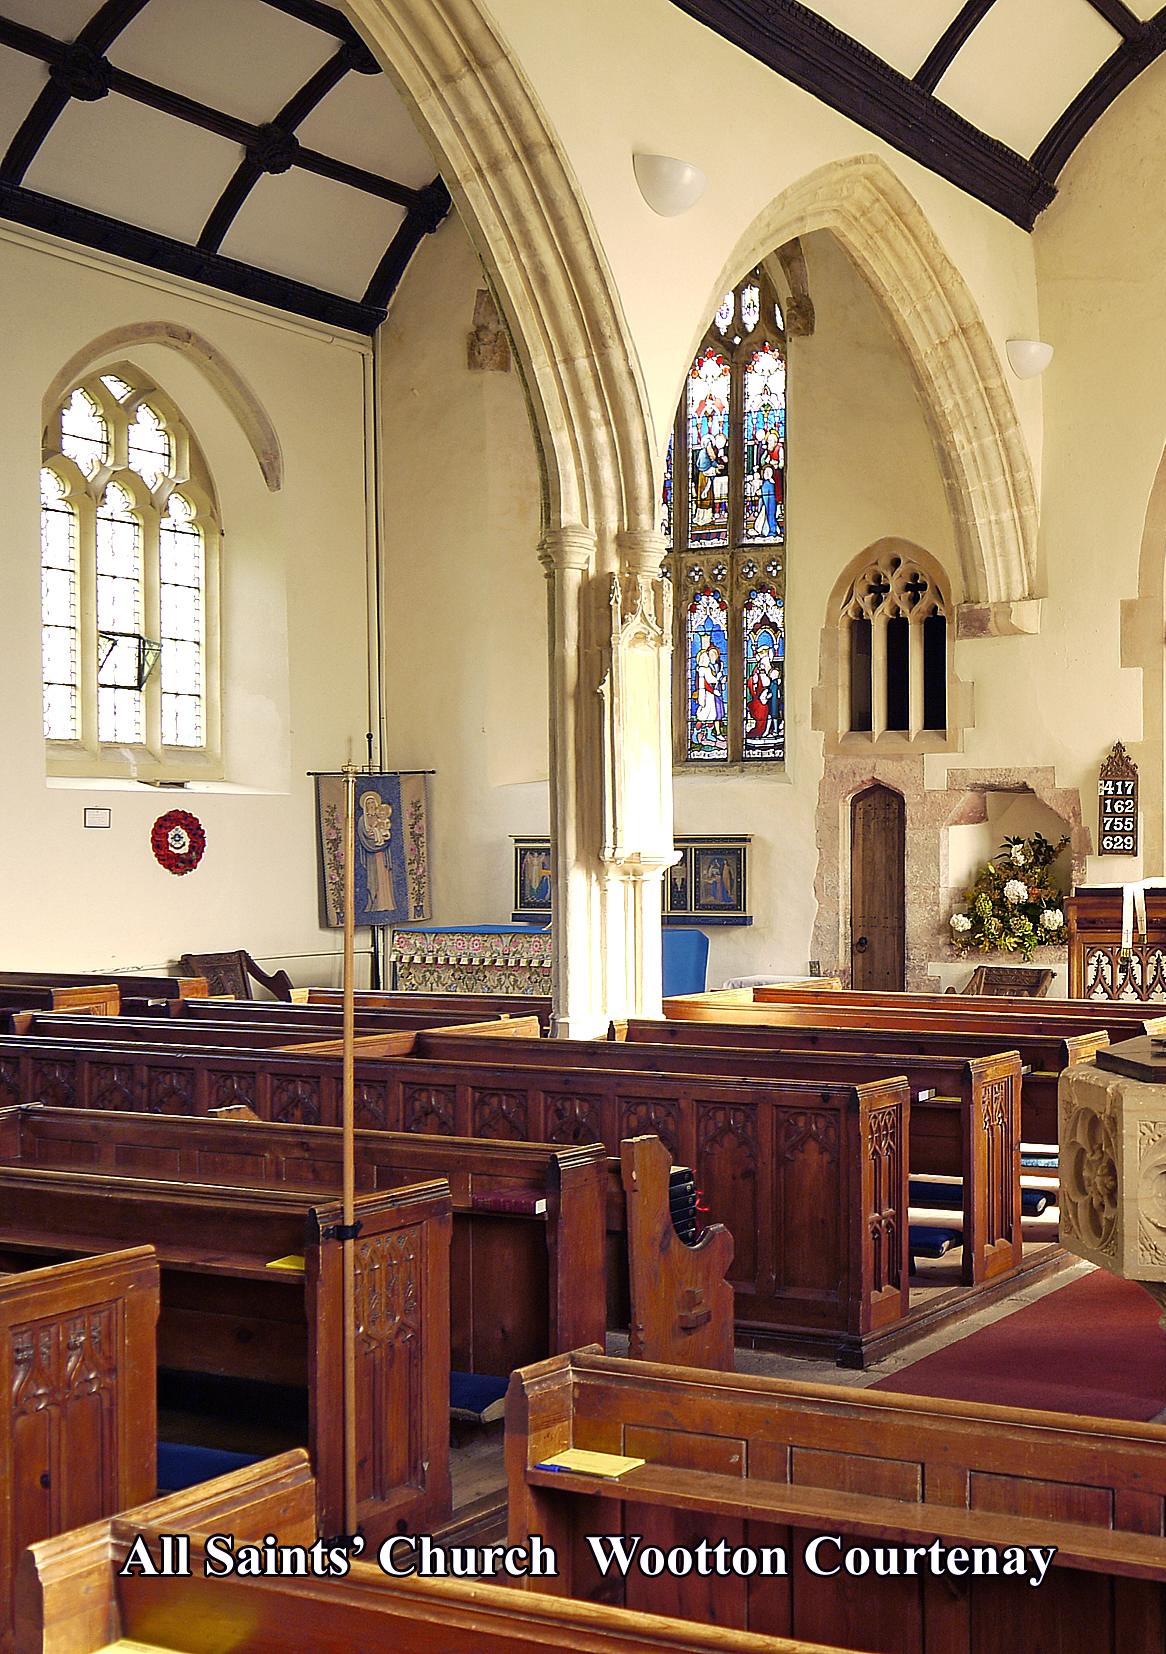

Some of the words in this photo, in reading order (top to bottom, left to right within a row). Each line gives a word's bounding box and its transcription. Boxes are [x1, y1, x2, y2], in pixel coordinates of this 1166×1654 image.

[1103, 781, 1135, 795] 417
[1104, 799, 1135, 813] 162
[1103, 817, 1134, 831] 755
[1102, 835, 1134, 850] 629
